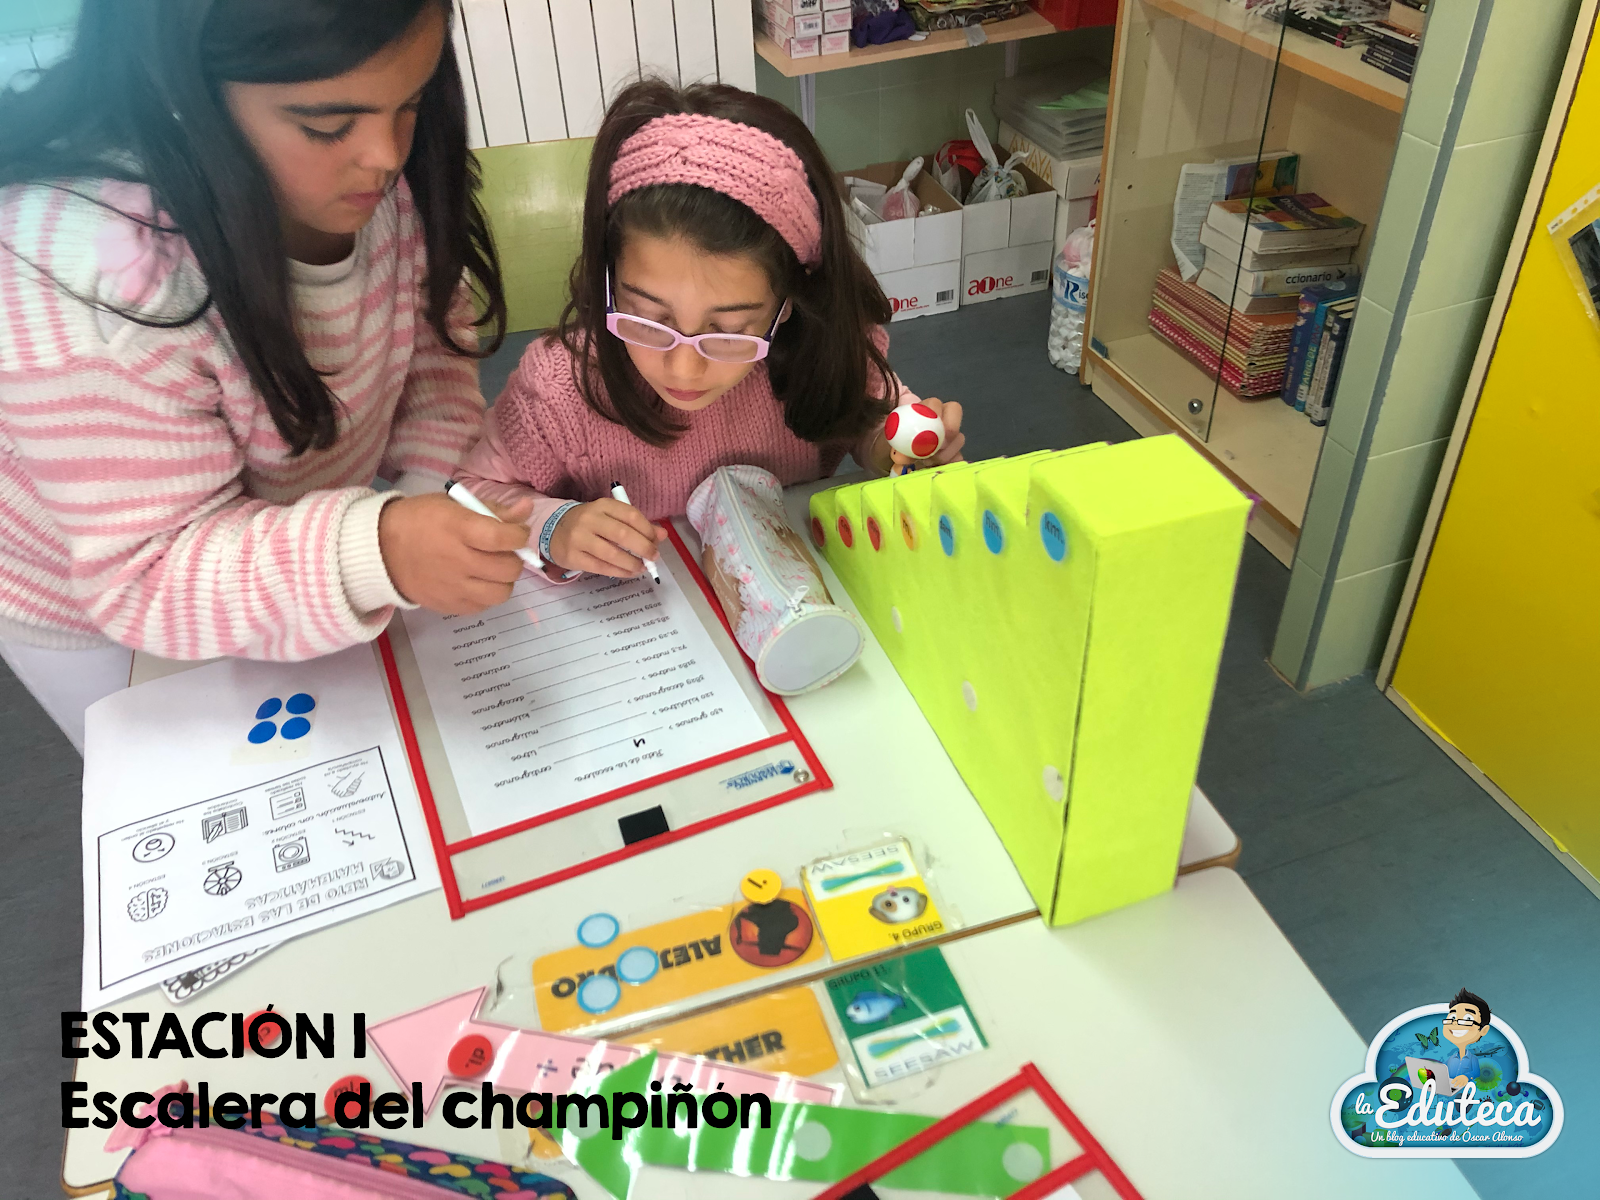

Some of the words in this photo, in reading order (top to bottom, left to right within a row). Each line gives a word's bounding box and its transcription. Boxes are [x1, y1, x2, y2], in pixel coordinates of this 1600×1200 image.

[453, 619, 485, 634] gramos
[612, 625, 640, 637] metros
[641, 650, 670, 662] metros
[647, 666, 676, 678] metros
[633, 682, 684, 703] decagramos
[471, 695, 525, 716] decagramos
[675, 710, 708, 727] gramos
[485, 729, 539, 750] miligramos
[510, 750, 537, 762] litros
[615, 760, 628, 768] la
[628, 756, 640, 765] de
[493, 765, 552, 788] centigramos
[574, 765, 614, 783] escalera
[811, 844, 899, 874] SEESAW
[244, 861, 365, 910] MATEMÁTICAS
[325, 877, 369, 902] RETO
[296, 892, 321, 910] DE
[258, 902, 293, 923] LAS
[902, 920, 944, 938] GRUPO
[142, 915, 255, 963] ESTACIONES
[695, 1030, 785, 1064] THER
[873, 1039, 974, 1079] SEESAW
